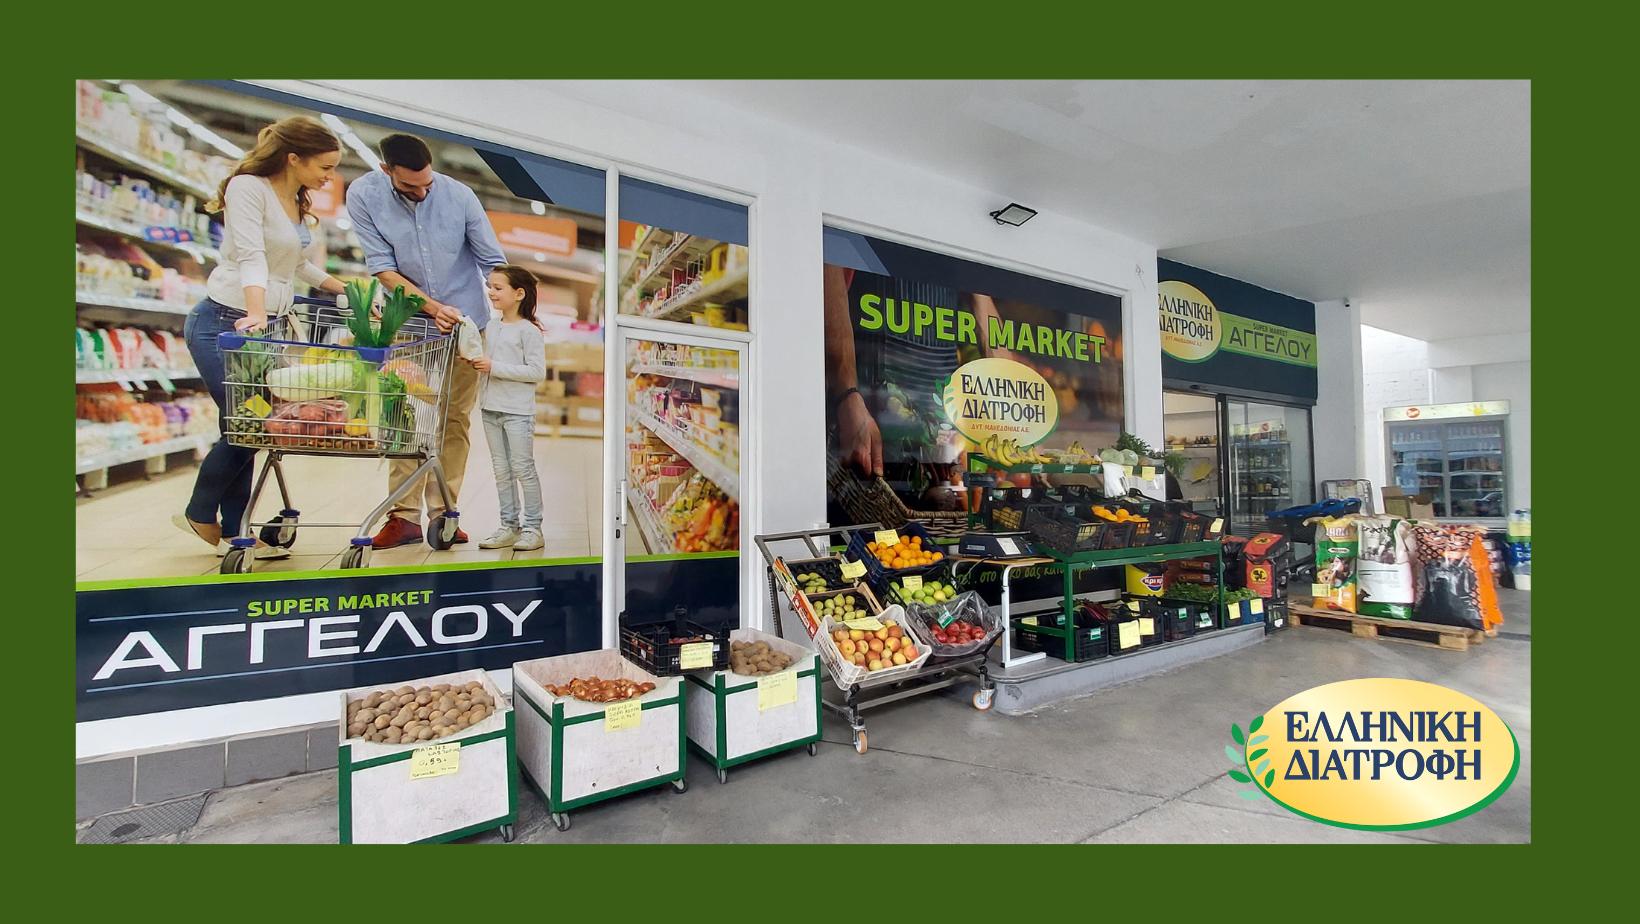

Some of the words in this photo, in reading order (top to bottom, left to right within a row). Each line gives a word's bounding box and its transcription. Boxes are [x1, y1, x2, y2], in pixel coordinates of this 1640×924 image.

[860, 293, 978, 345] SUPER
[988, 315, 1105, 364] MARKET
[1229, 326, 1311, 359] ΑΓΓΕΛΟΥ
[961, 374, 1045, 401] ΕΛΛΗΝΙΚΗ
[961, 399, 1046, 423] ΔΙΑΤΡΟΦΗ
[247, 596, 330, 617] SUPER
[338, 590, 434, 611] MARKET
[92, 599, 543, 680] ΑΓΓΕΛΟΥ
